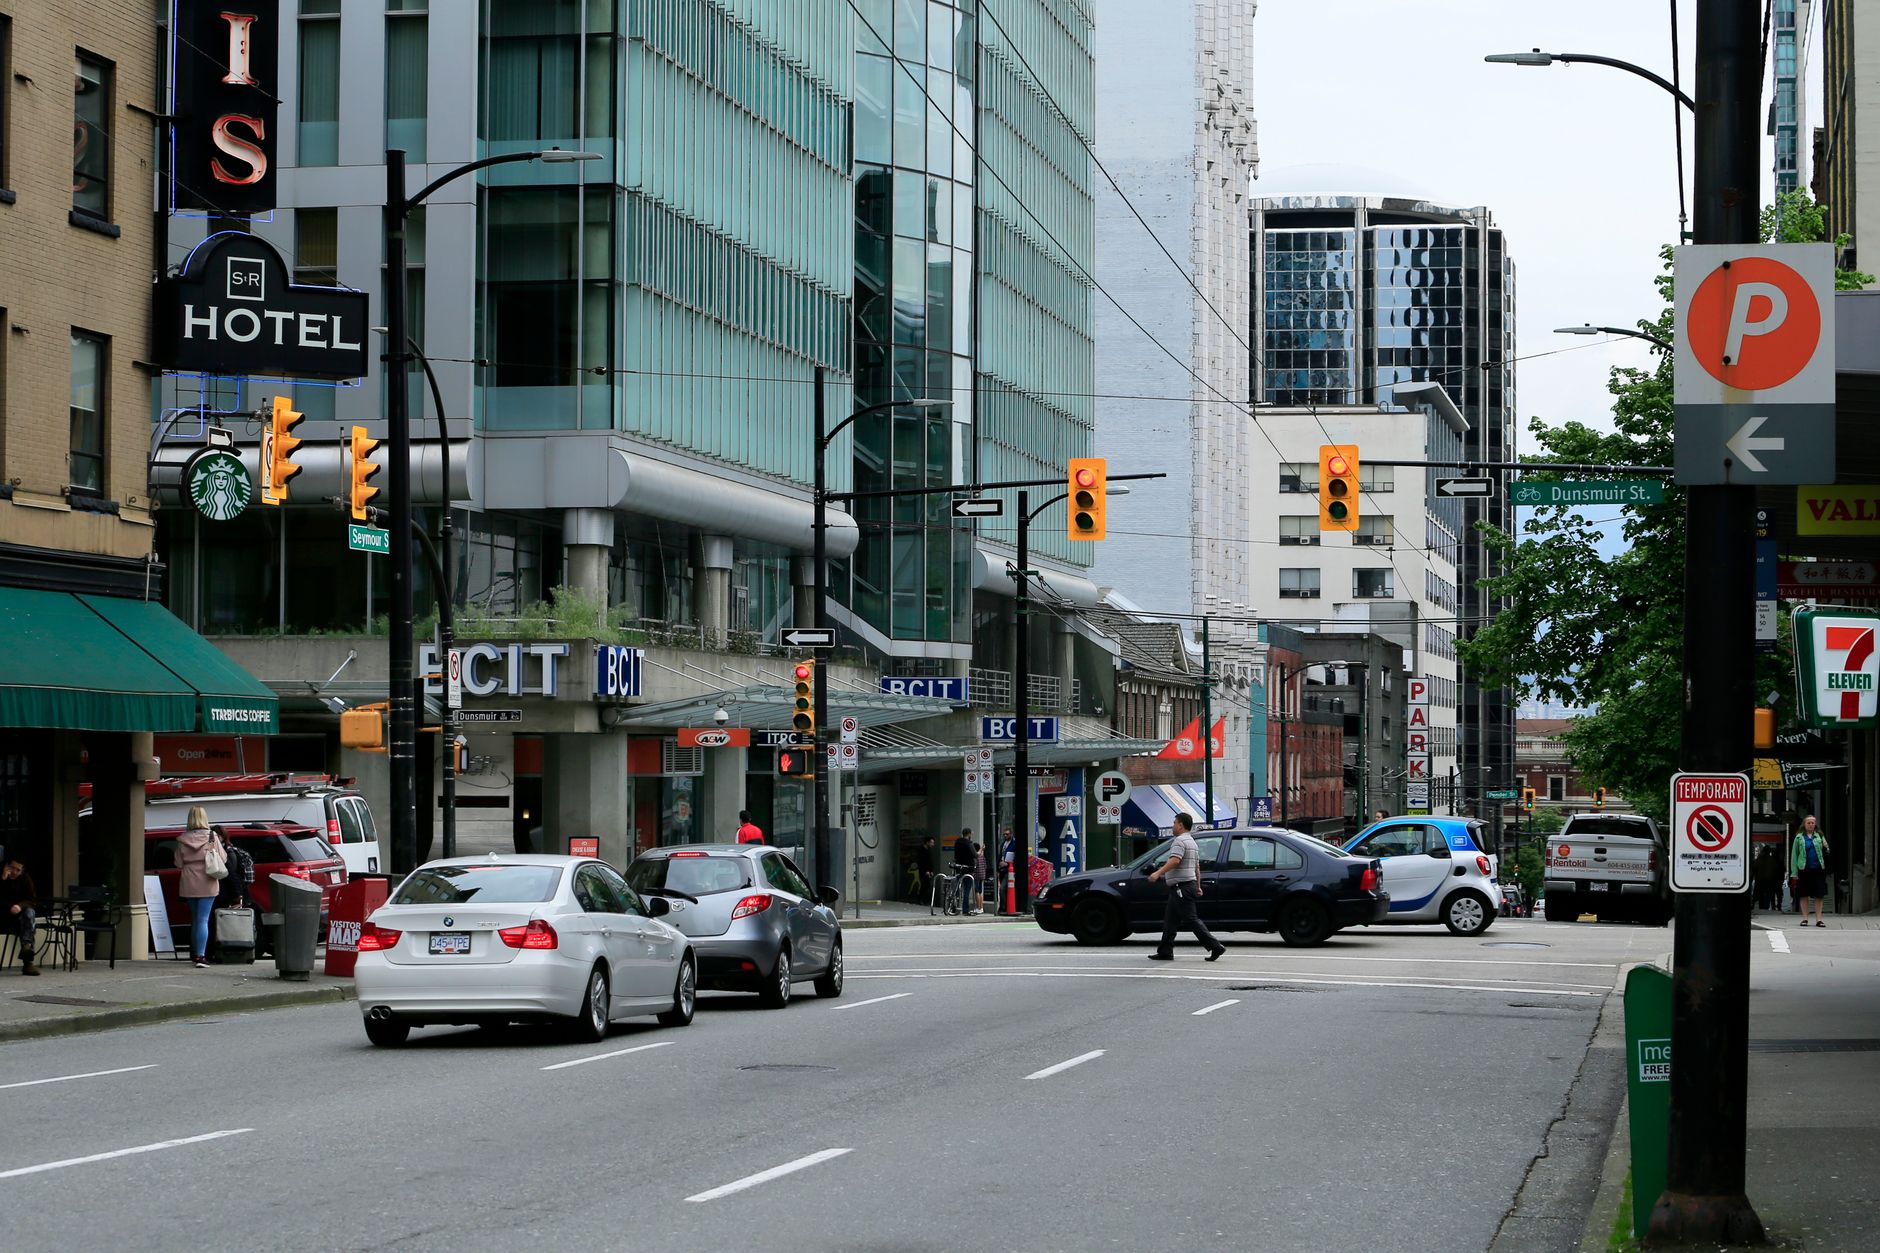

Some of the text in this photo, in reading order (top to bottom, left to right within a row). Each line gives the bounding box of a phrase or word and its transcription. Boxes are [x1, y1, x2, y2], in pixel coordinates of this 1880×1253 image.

[184, 304, 361, 352] HOTEL
[1722, 282, 1788, 366] P
[1552, 486, 1650, 501] Dunsmuir St.
[353, 528, 389, 548] Seymour S
[608, 646, 645, 697] BCIT
[1826, 627, 1874, 720] 7
[460, 712, 497, 721] Dunsmuir
[990, 719, 1046, 738] BCT
[1409, 682, 1426, 778] PARK
[701, 735, 727, 744] A&W
[1777, 732, 1808, 743] Every
[178, 748, 204, 760] Open
[1781, 761, 1792, 772] is
[1785, 772, 1808, 785] free
[1679, 782, 1742, 799] TEMPORARY
[1059, 820, 1078, 876] ARK
[1553, 860, 1587, 868] Rentokil
[330, 920, 362, 930] VISITOR
[328, 928, 361, 945] MAP
[453, 938, 469, 949] TPE
[1645, 1046, 1671, 1060] me
[1644, 1064, 1670, 1074] FREE
